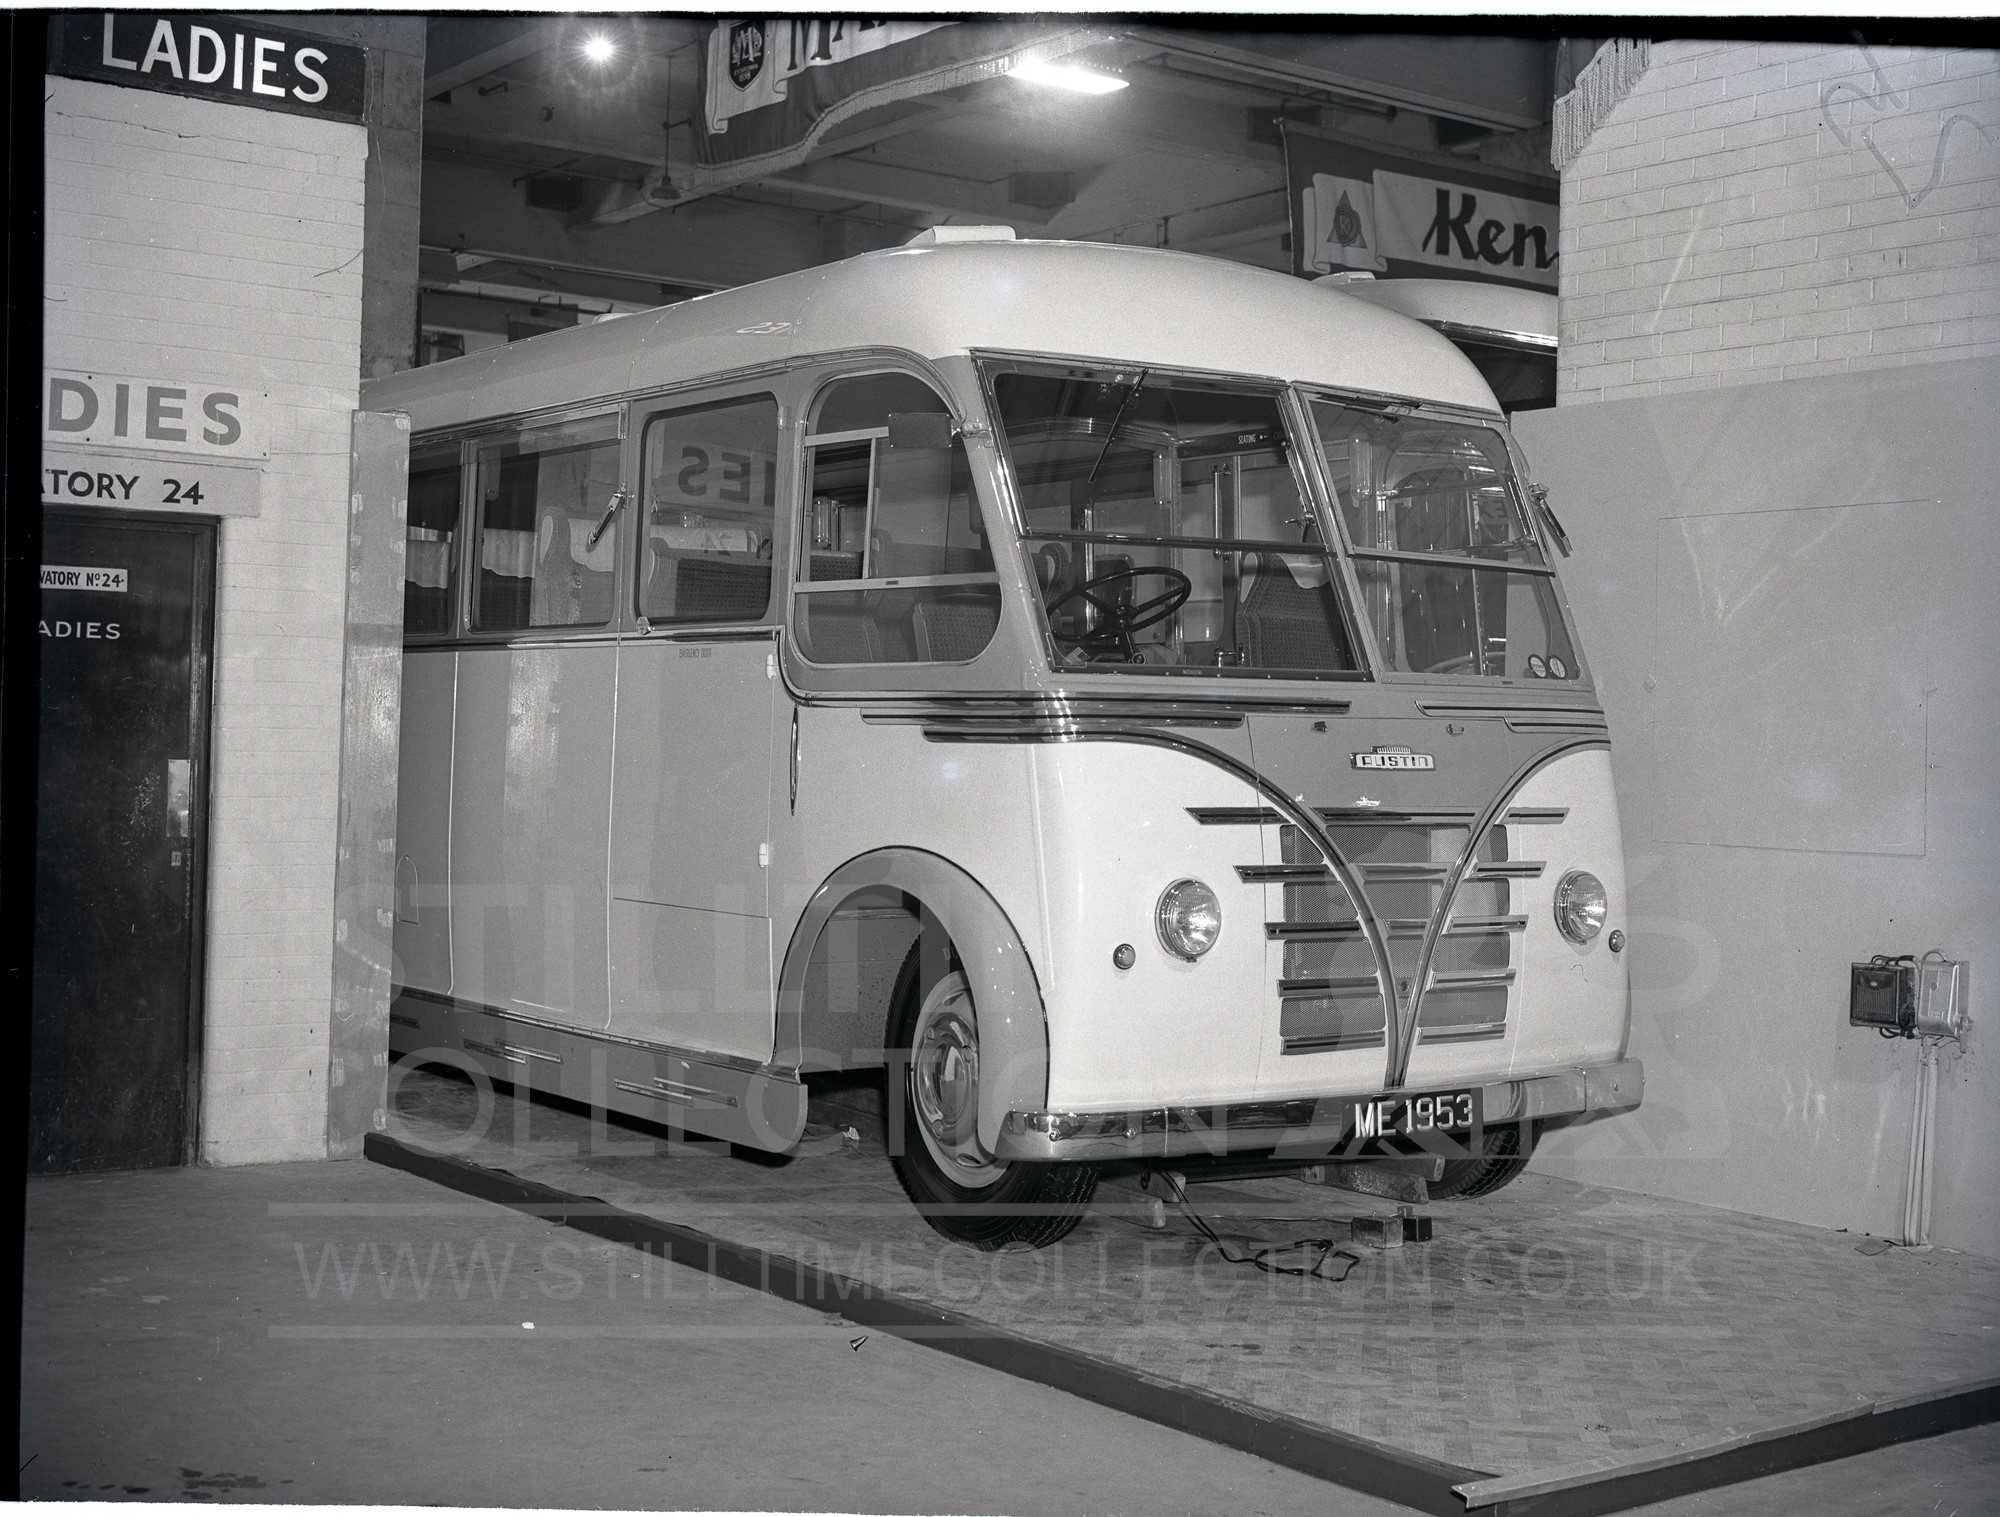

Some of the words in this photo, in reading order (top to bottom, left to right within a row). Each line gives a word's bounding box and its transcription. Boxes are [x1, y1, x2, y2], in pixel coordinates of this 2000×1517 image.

[102, 13, 329, 103] LADIES
[48, 377, 242, 446] DIES
[42, 468, 140, 501] TORY
[162, 478, 204, 505] 24
[39, 619, 121, 640] ADIES
[1355, 1101, 1396, 1138] ME
[1405, 1094, 1473, 1134] 1953
